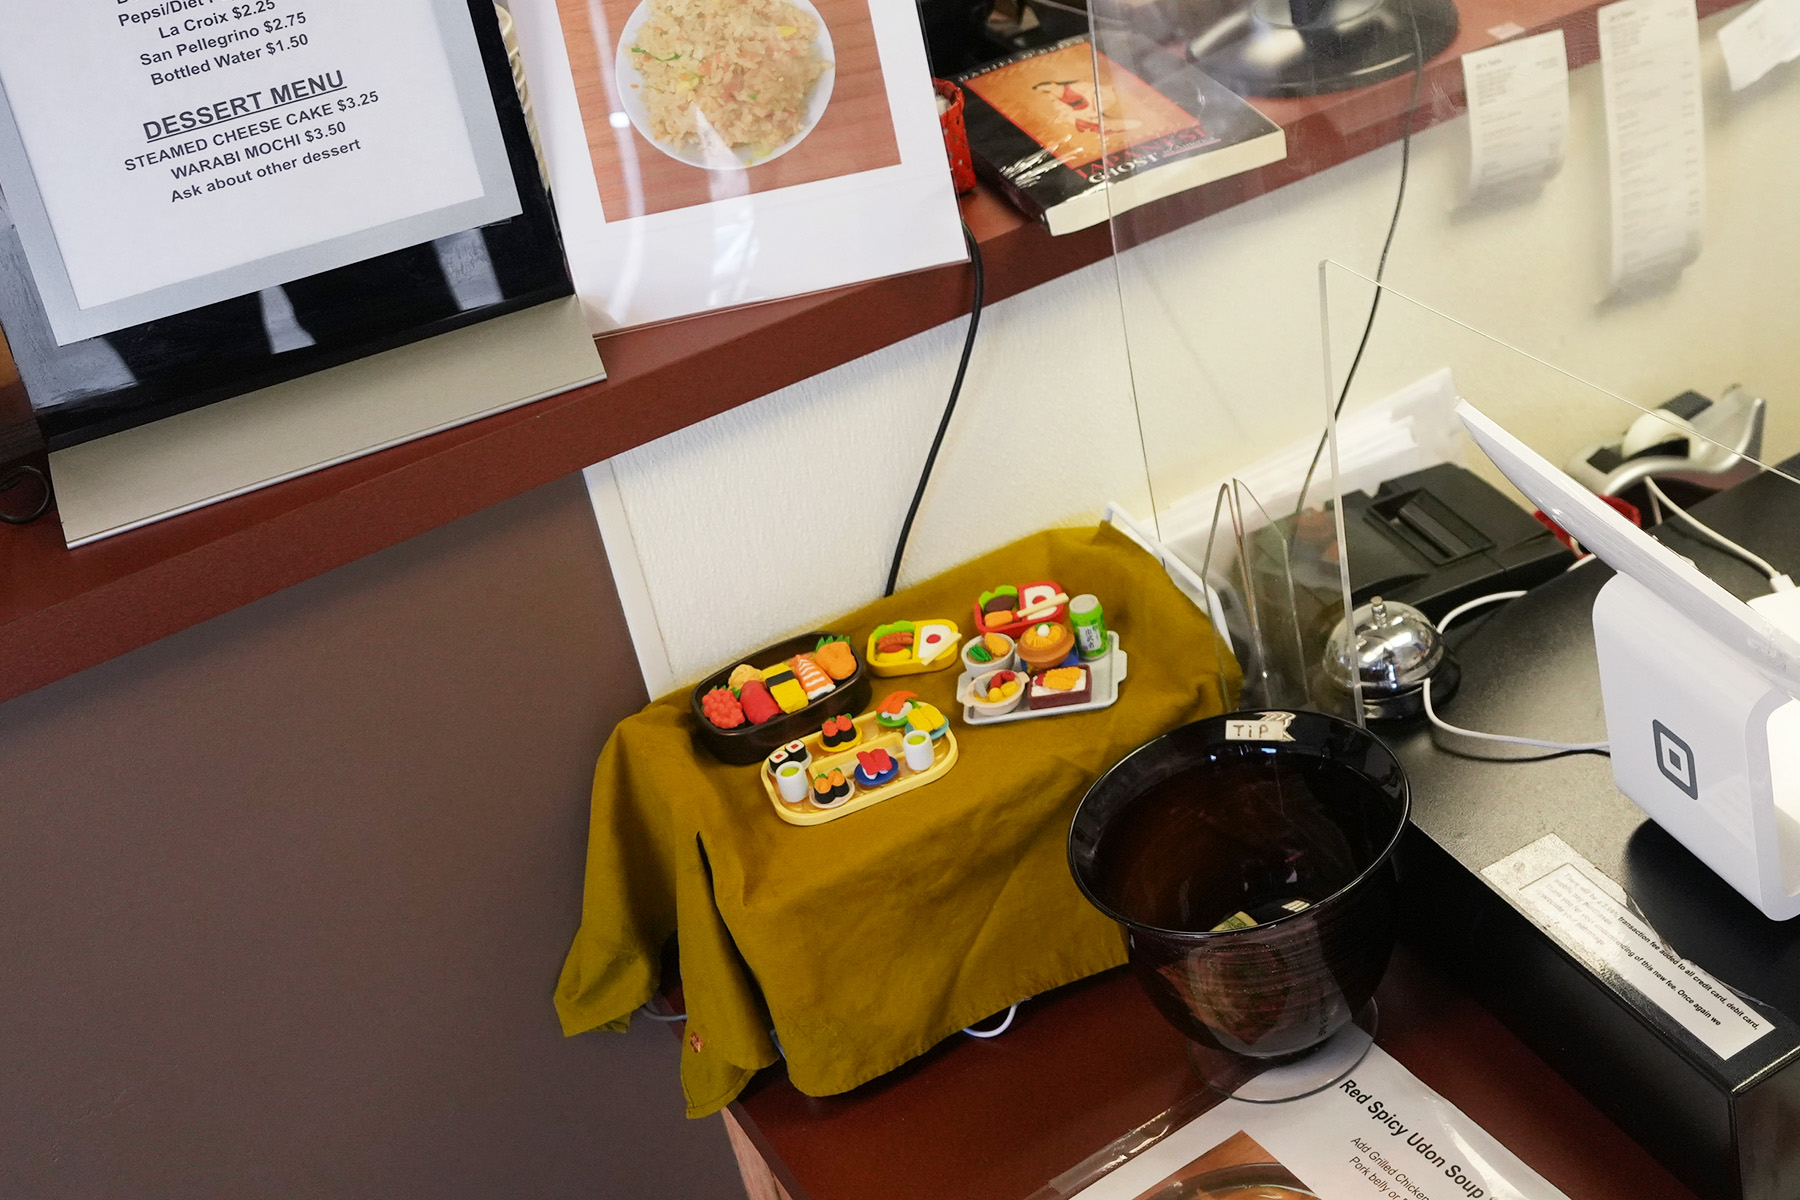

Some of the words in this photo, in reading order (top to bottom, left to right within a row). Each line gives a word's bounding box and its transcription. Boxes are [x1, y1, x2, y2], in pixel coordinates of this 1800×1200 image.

[140, 51, 173, 66] San
[176, 27, 259, 56] Pellegrino
[263, 11, 306, 34] $2.75
[158, 26, 180, 39] La
[184, 12, 229, 31] Croix
[150, 59, 211, 86] Bottled
[213, 48, 261, 68] Water
[266, 34, 308, 55] $1.50
[124, 139, 208, 171] STEAMED
[213, 117, 282, 146] CHEESE
[286, 103, 334, 125] CAKE
[337, 91, 378, 112] $3.25
[143, 91, 262, 140] DESSERT
[270, 70, 343, 105] MENU
[170, 151, 241, 179] WARABI
[244, 134, 301, 159] MOCHI
[304, 121, 346, 143] $3.50
[172, 185, 202, 203] Ask
[206, 170, 253, 192] about
[257, 159, 297, 177] other
[302, 139, 361, 164] dessert
[1618, 916, 1650, 943] transaction
[1650, 940, 1660, 951] fee
[1659, 948, 1679, 965] added
[1677, 961, 1686, 971] to
[1685, 968, 1694, 978] all
[1693, 975, 1712, 992] credit
[1711, 989, 1727, 1004] card,
[1726, 1001, 1744, 1017] debit
[1743, 1014, 1760, 1030] card,
[1641, 959, 1654, 972] this
[1653, 970, 1667, 982] new
[1665, 979, 1676, 991] fee.
[1677, 989, 1694, 1004] Once
[1693, 1001, 1711, 1018] again
[1711, 1016, 1721, 1026] we
[1339, 1079, 1373, 1105] Red
[1367, 1101, 1408, 1136] Spicy
[1407, 1132, 1446, 1168] Udon
[1445, 1164, 1485, 1200] Soup
[1351, 1137, 1372, 1153] Add
[1369, 1151, 1398, 1176] Grilled
[1349, 1156, 1372, 1176] Pork
[1368, 1172, 1391, 1193] belly
